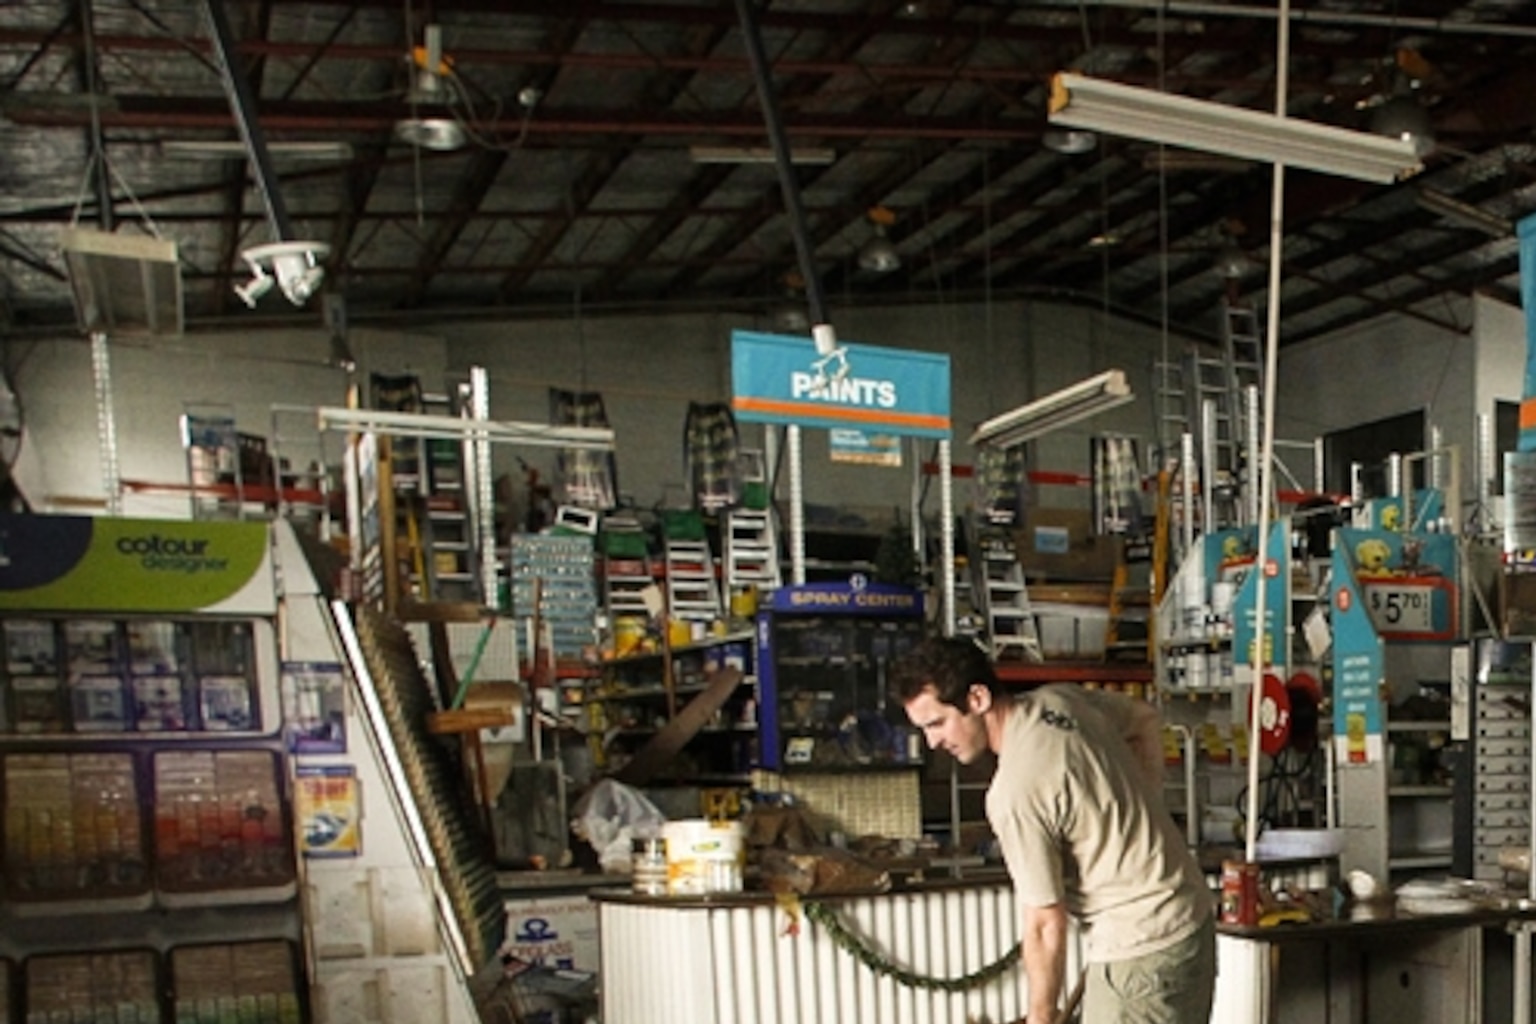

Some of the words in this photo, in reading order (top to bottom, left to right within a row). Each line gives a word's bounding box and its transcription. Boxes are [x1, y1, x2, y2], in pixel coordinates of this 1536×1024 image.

[791, 371, 897, 408] PAINTS
[116, 535, 209, 556] colour
[141, 557, 227, 573] designer
[790, 591, 849, 606] SPRAY
[855, 593, 914, 607] CENTER
